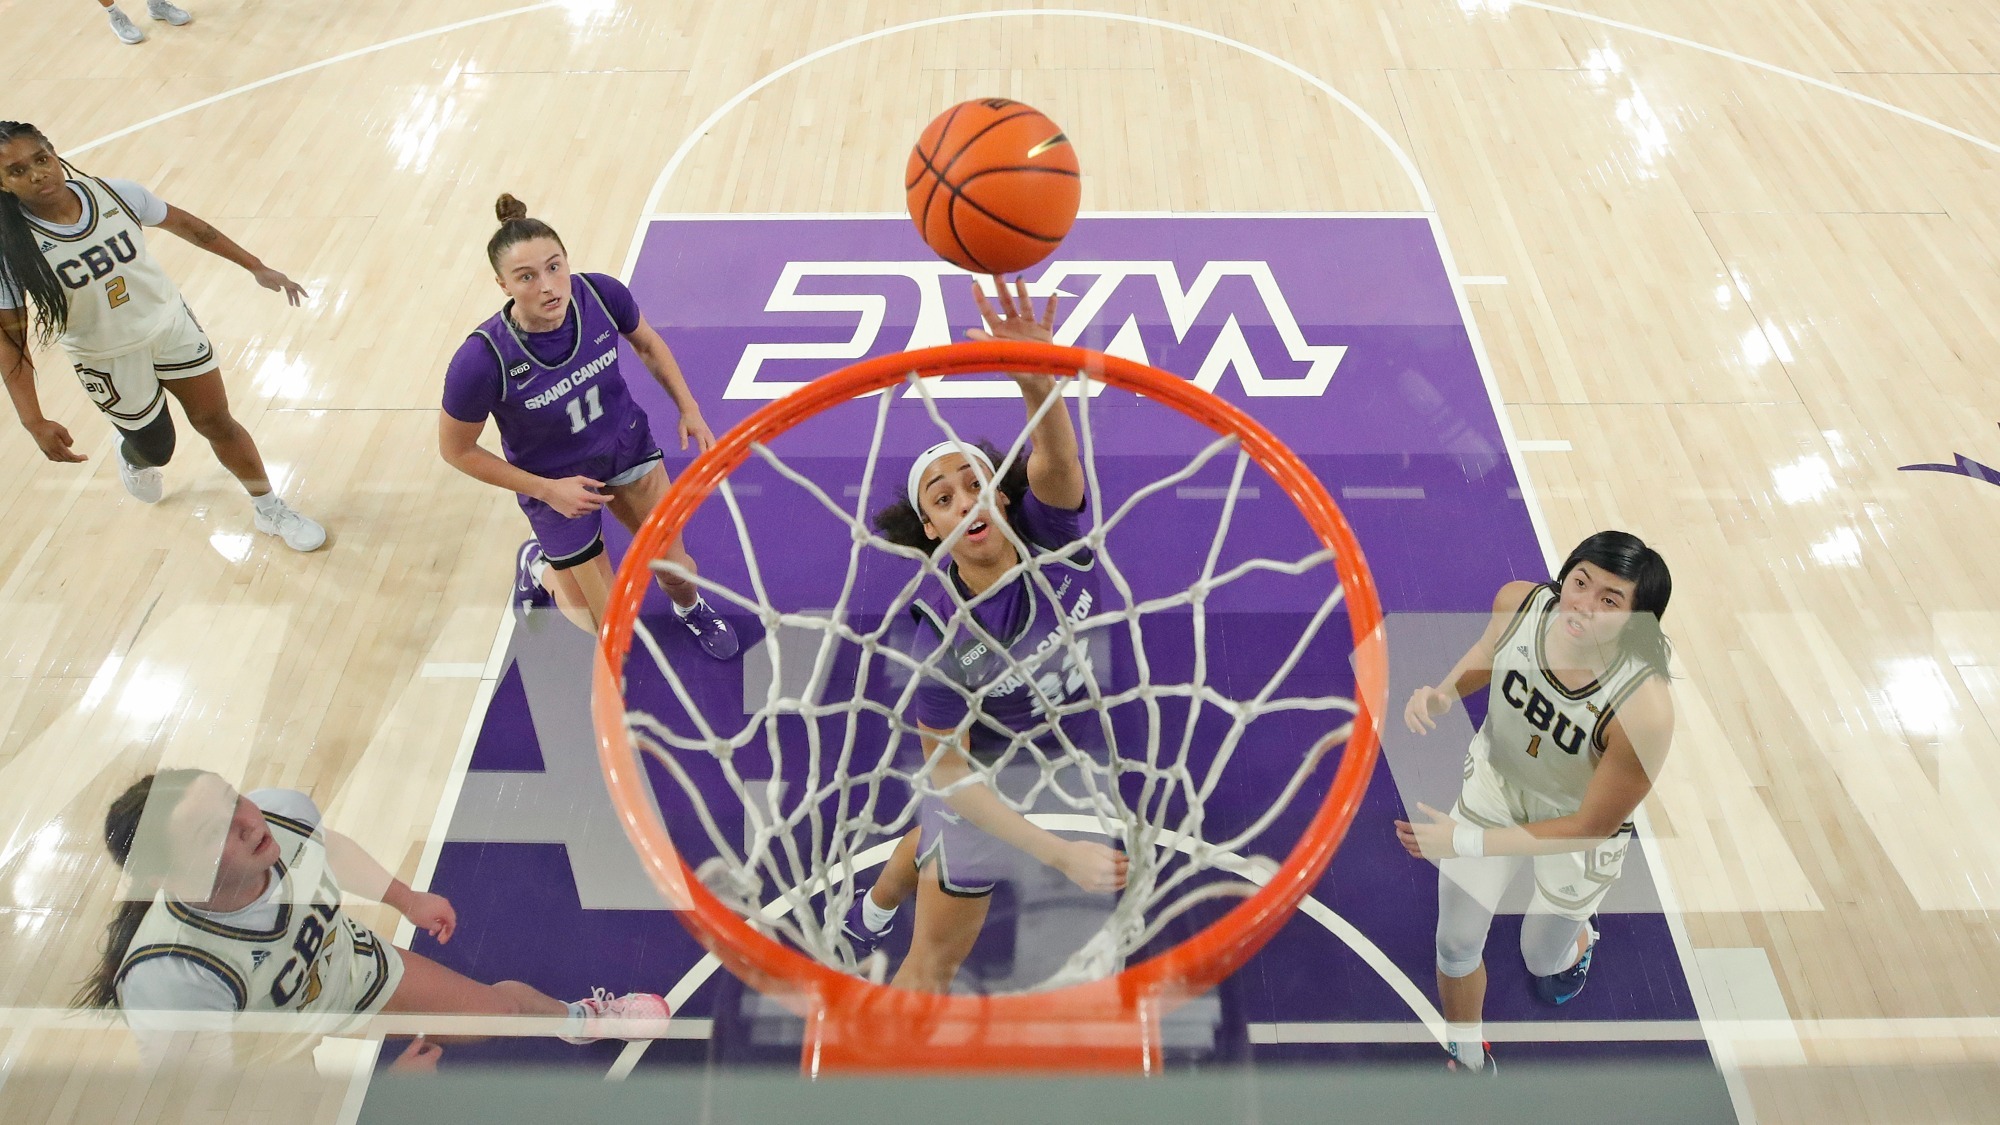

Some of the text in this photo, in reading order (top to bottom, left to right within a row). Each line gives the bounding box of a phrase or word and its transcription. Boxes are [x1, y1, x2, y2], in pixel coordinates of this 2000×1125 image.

[56, 229, 137, 290] CBU
[105, 275, 130, 309] 2
[593, 329, 610, 345] WAC
[81, 380, 105, 393] BU
[525, 347, 618, 411] GRAND CANYON
[565, 384, 605, 435] 11
[1055, 574, 1072, 600] WAC
[1501, 669, 1587, 755] CBU
[1526, 734, 1541, 758] 1
[270, 868, 341, 1008] CBU
